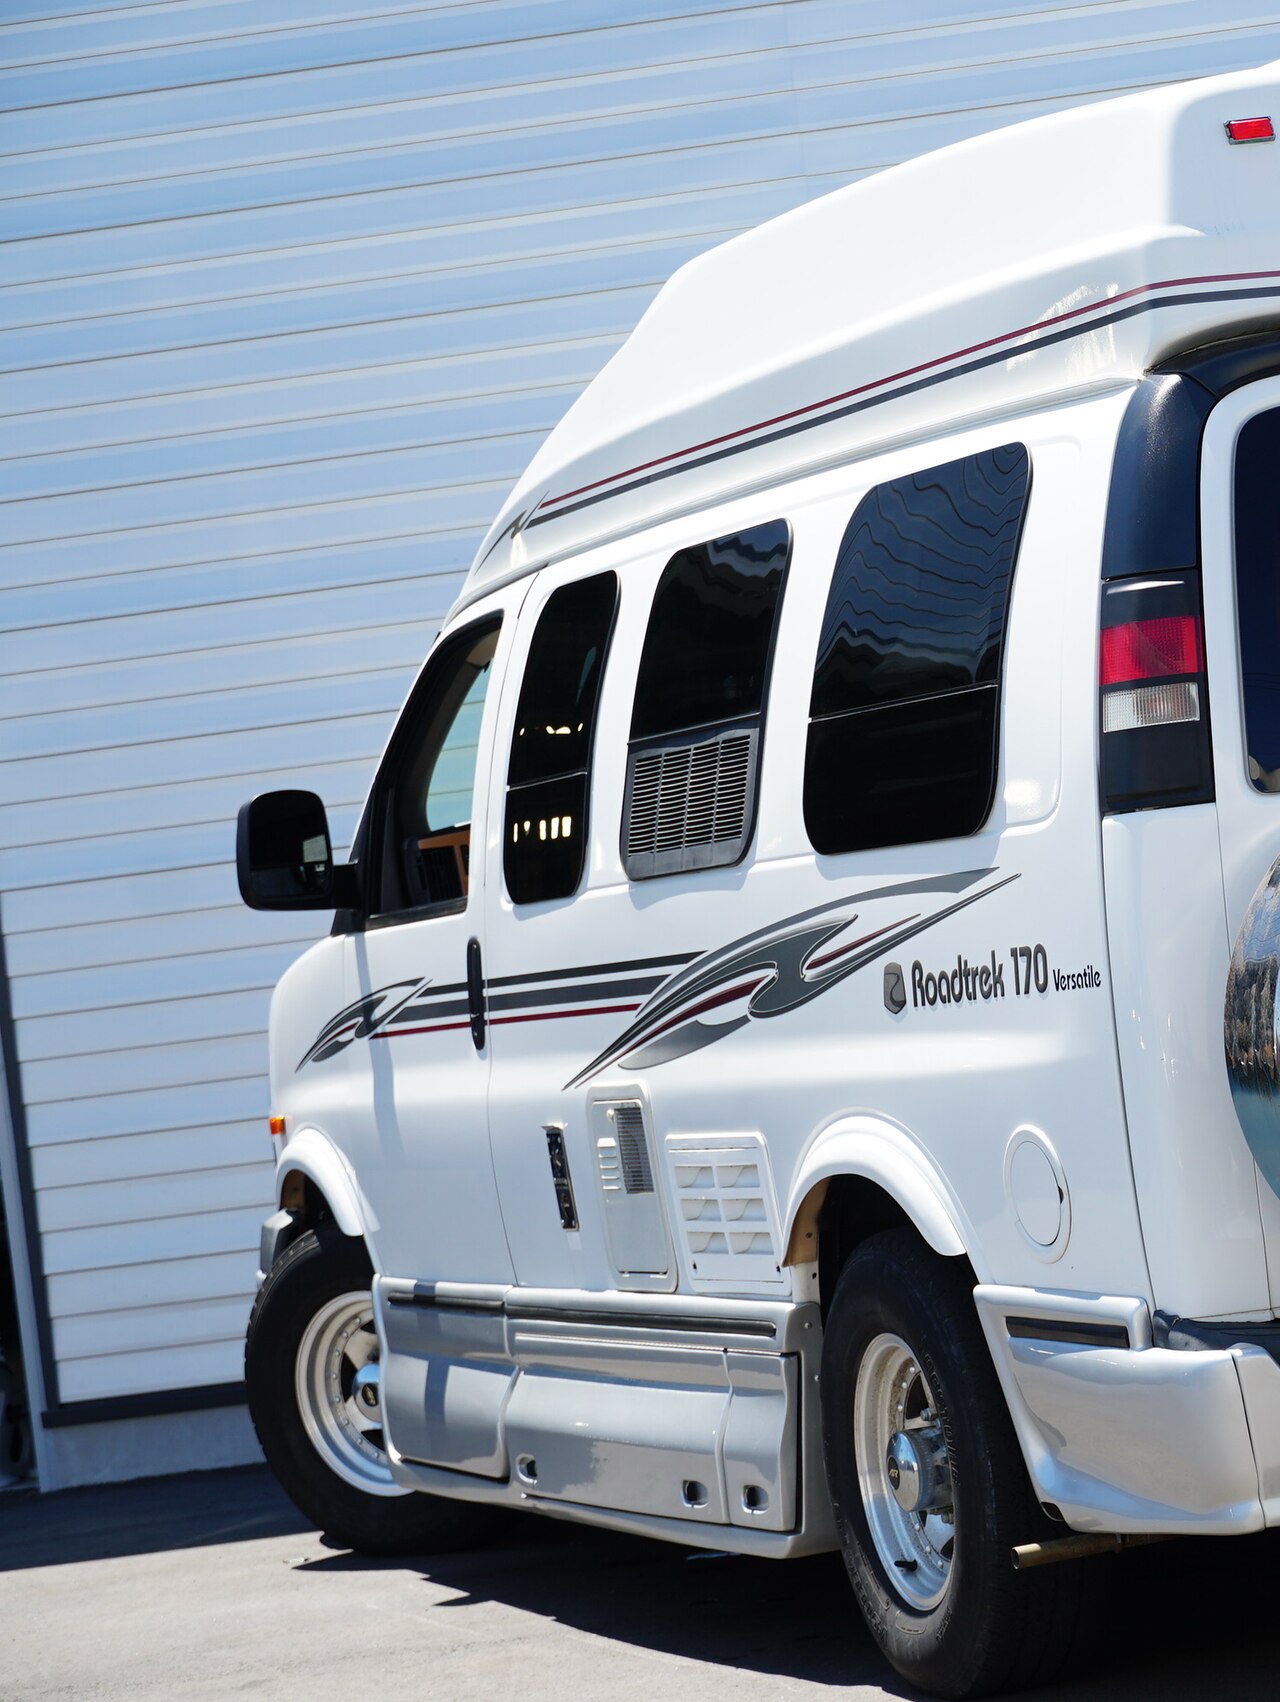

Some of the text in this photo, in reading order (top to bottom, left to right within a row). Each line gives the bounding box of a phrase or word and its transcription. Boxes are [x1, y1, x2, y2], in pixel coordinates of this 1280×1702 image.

[911, 943, 1102, 1008] Roadtrek 170 Versatile
